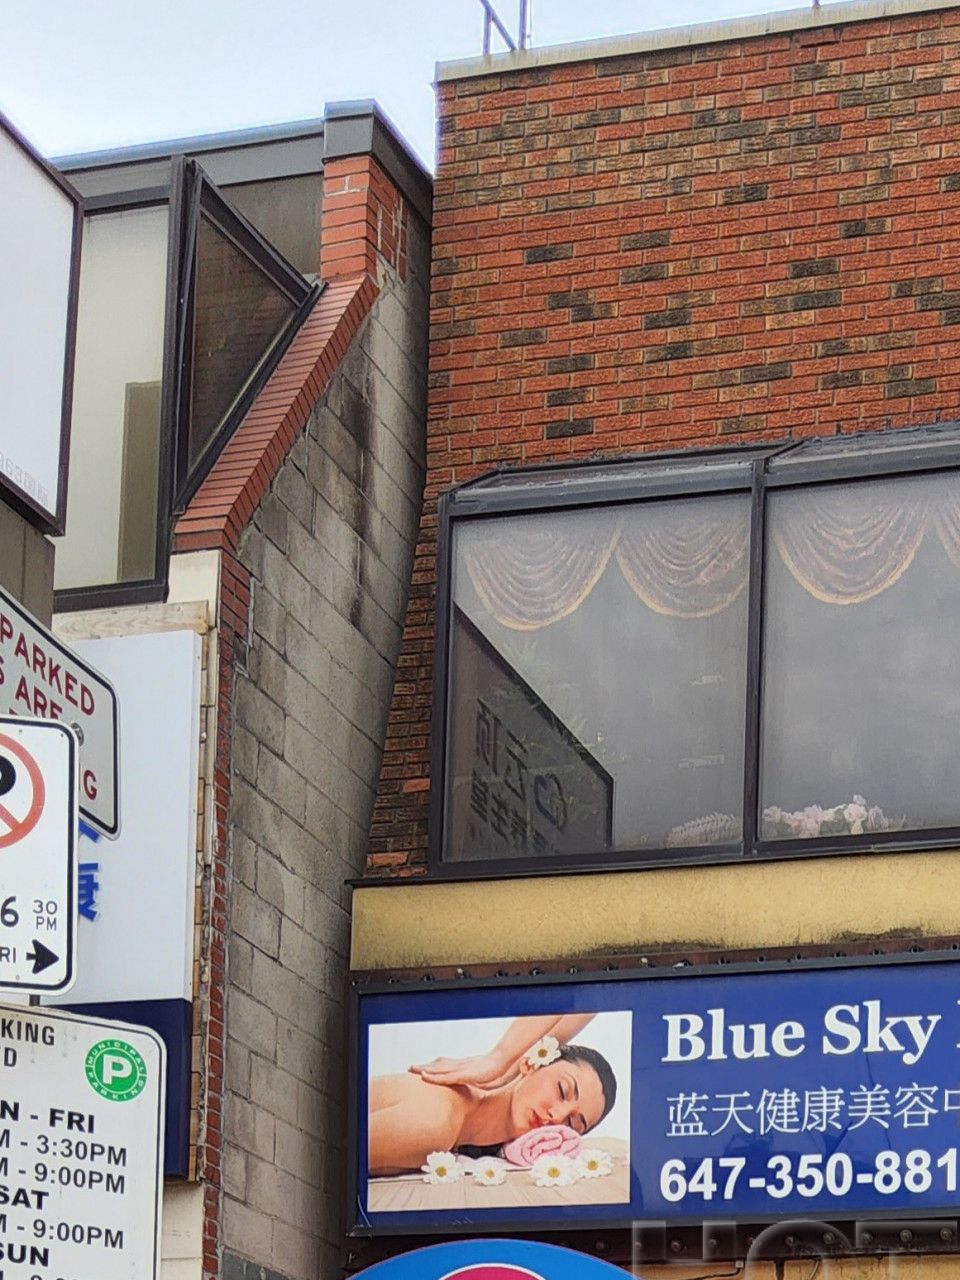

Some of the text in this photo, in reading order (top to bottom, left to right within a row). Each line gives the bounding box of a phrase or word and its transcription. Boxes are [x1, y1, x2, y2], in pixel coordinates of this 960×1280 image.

[0, 613, 95, 716] PARKED
[36, 916, 56, 931] PM
[661, 1008, 805, 1063] Blue
[822, 1001, 941, 1066] Sky
[87, 1042, 145, 1071] MUNICIPAL
[88, 1072, 145, 1100] PARKING
[50, 1108, 94, 1133] FRI
[36, 1134, 127, 1167] 3:30PM
[34, 1162, 126, 1195] 9:00PM
[33, 1218, 124, 1250] 9:00PM
